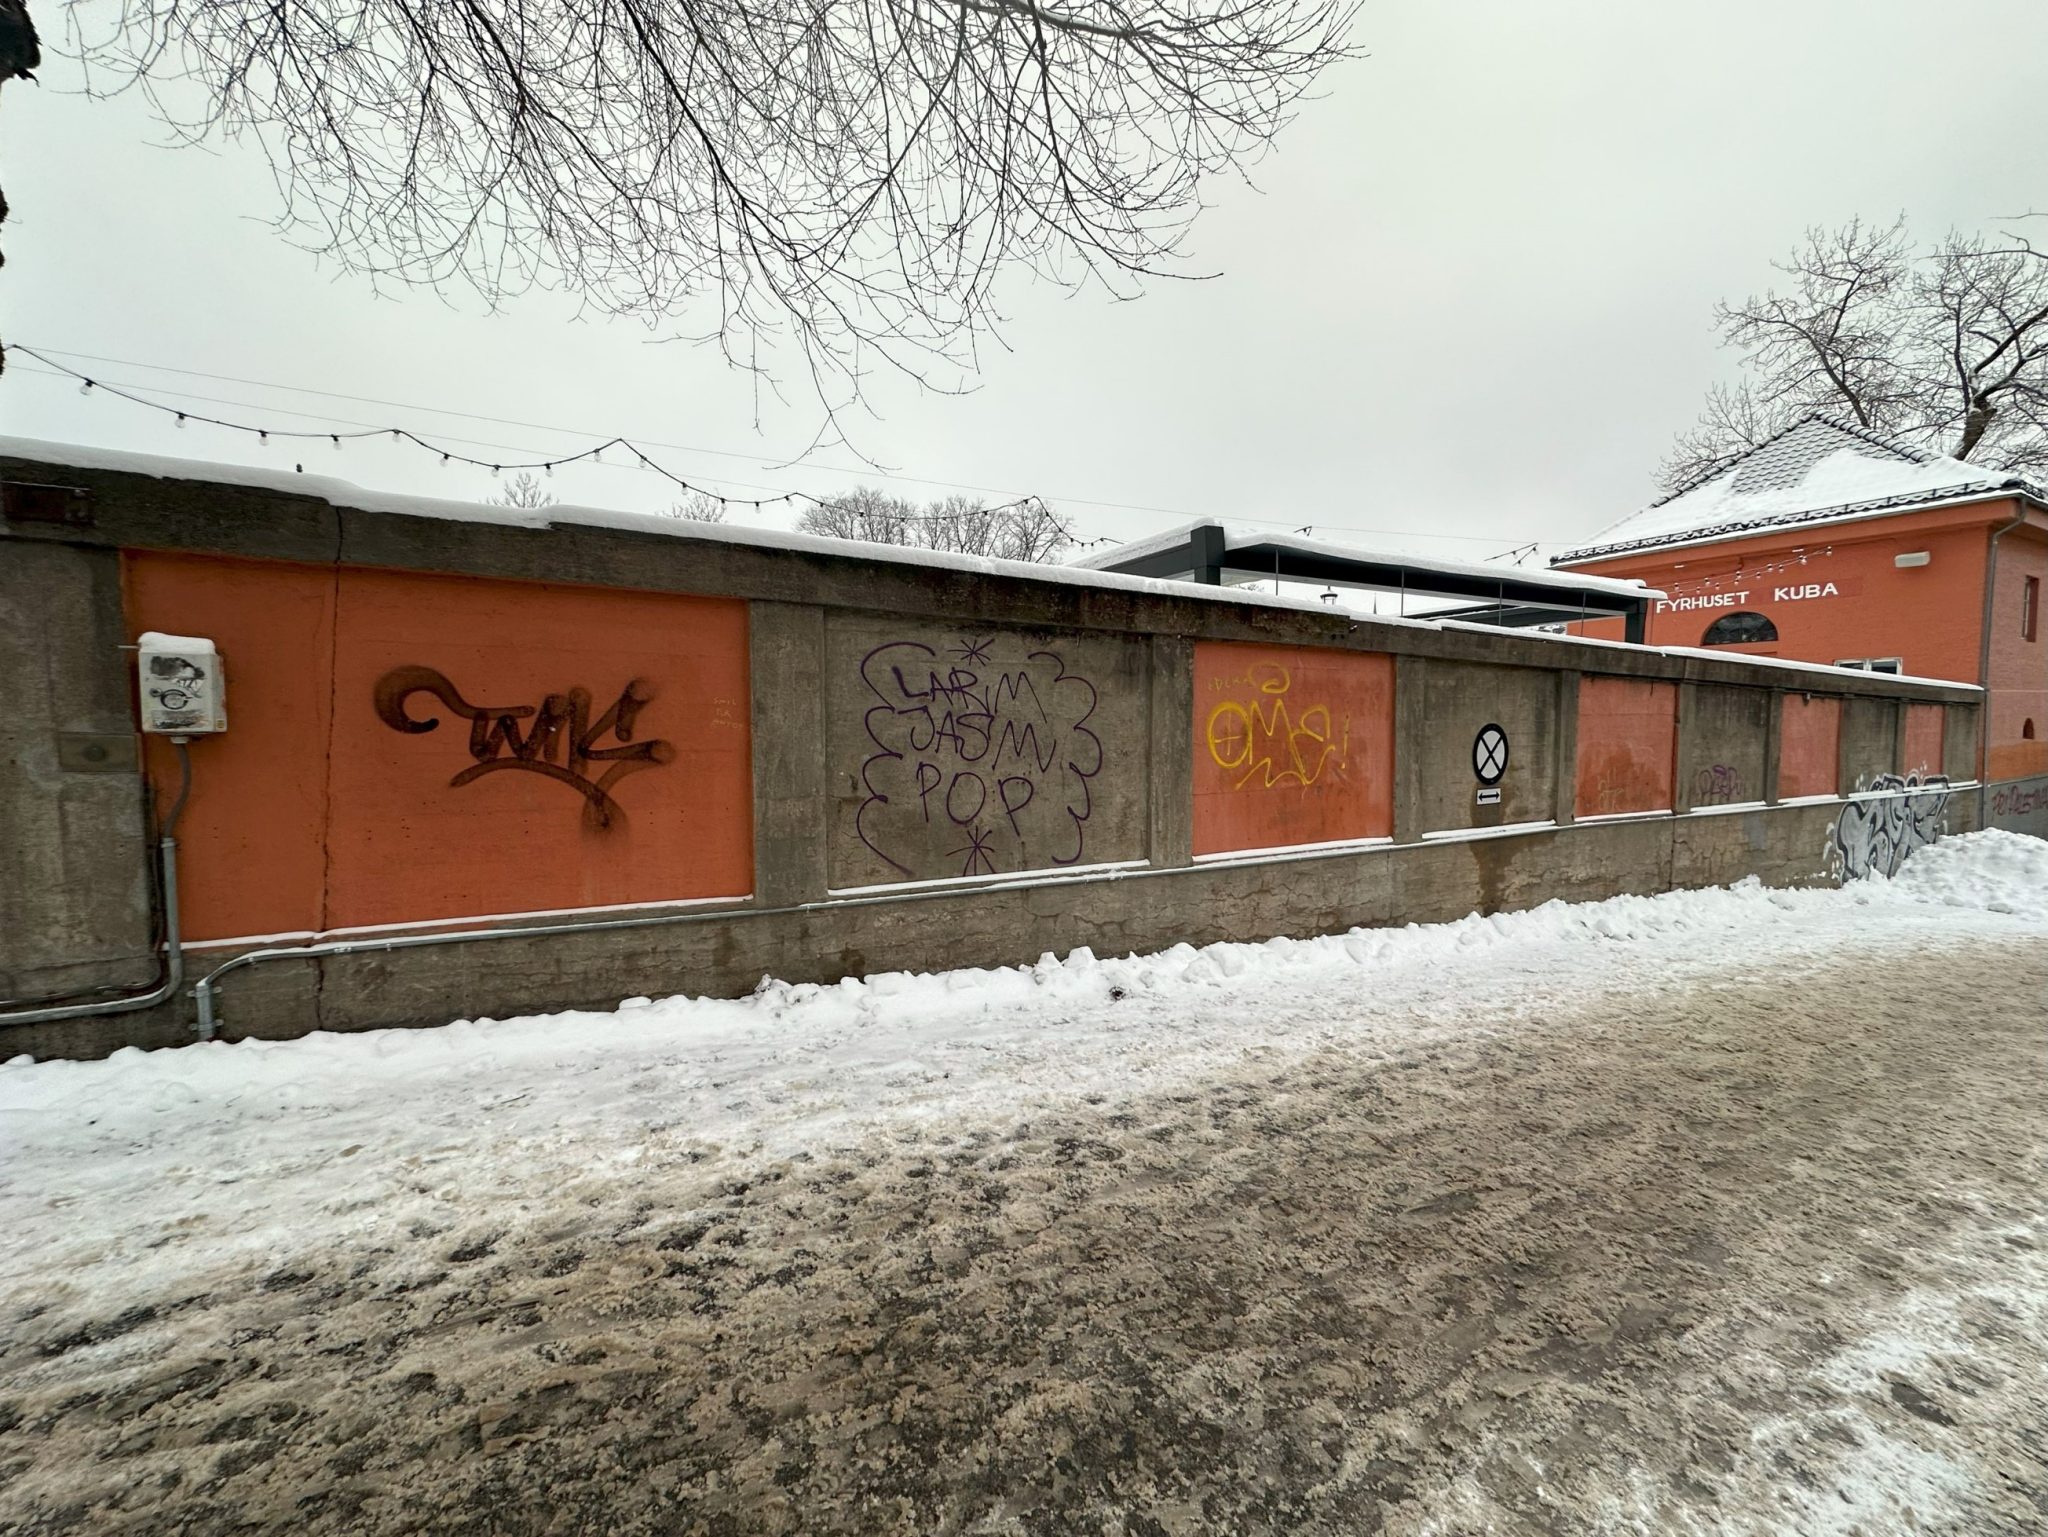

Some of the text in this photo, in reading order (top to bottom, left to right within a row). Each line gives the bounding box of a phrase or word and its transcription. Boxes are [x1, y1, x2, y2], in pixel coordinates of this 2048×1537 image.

[1656, 582, 1839, 614] FYRHUSET KUBA
[916, 761, 1035, 837] POP
